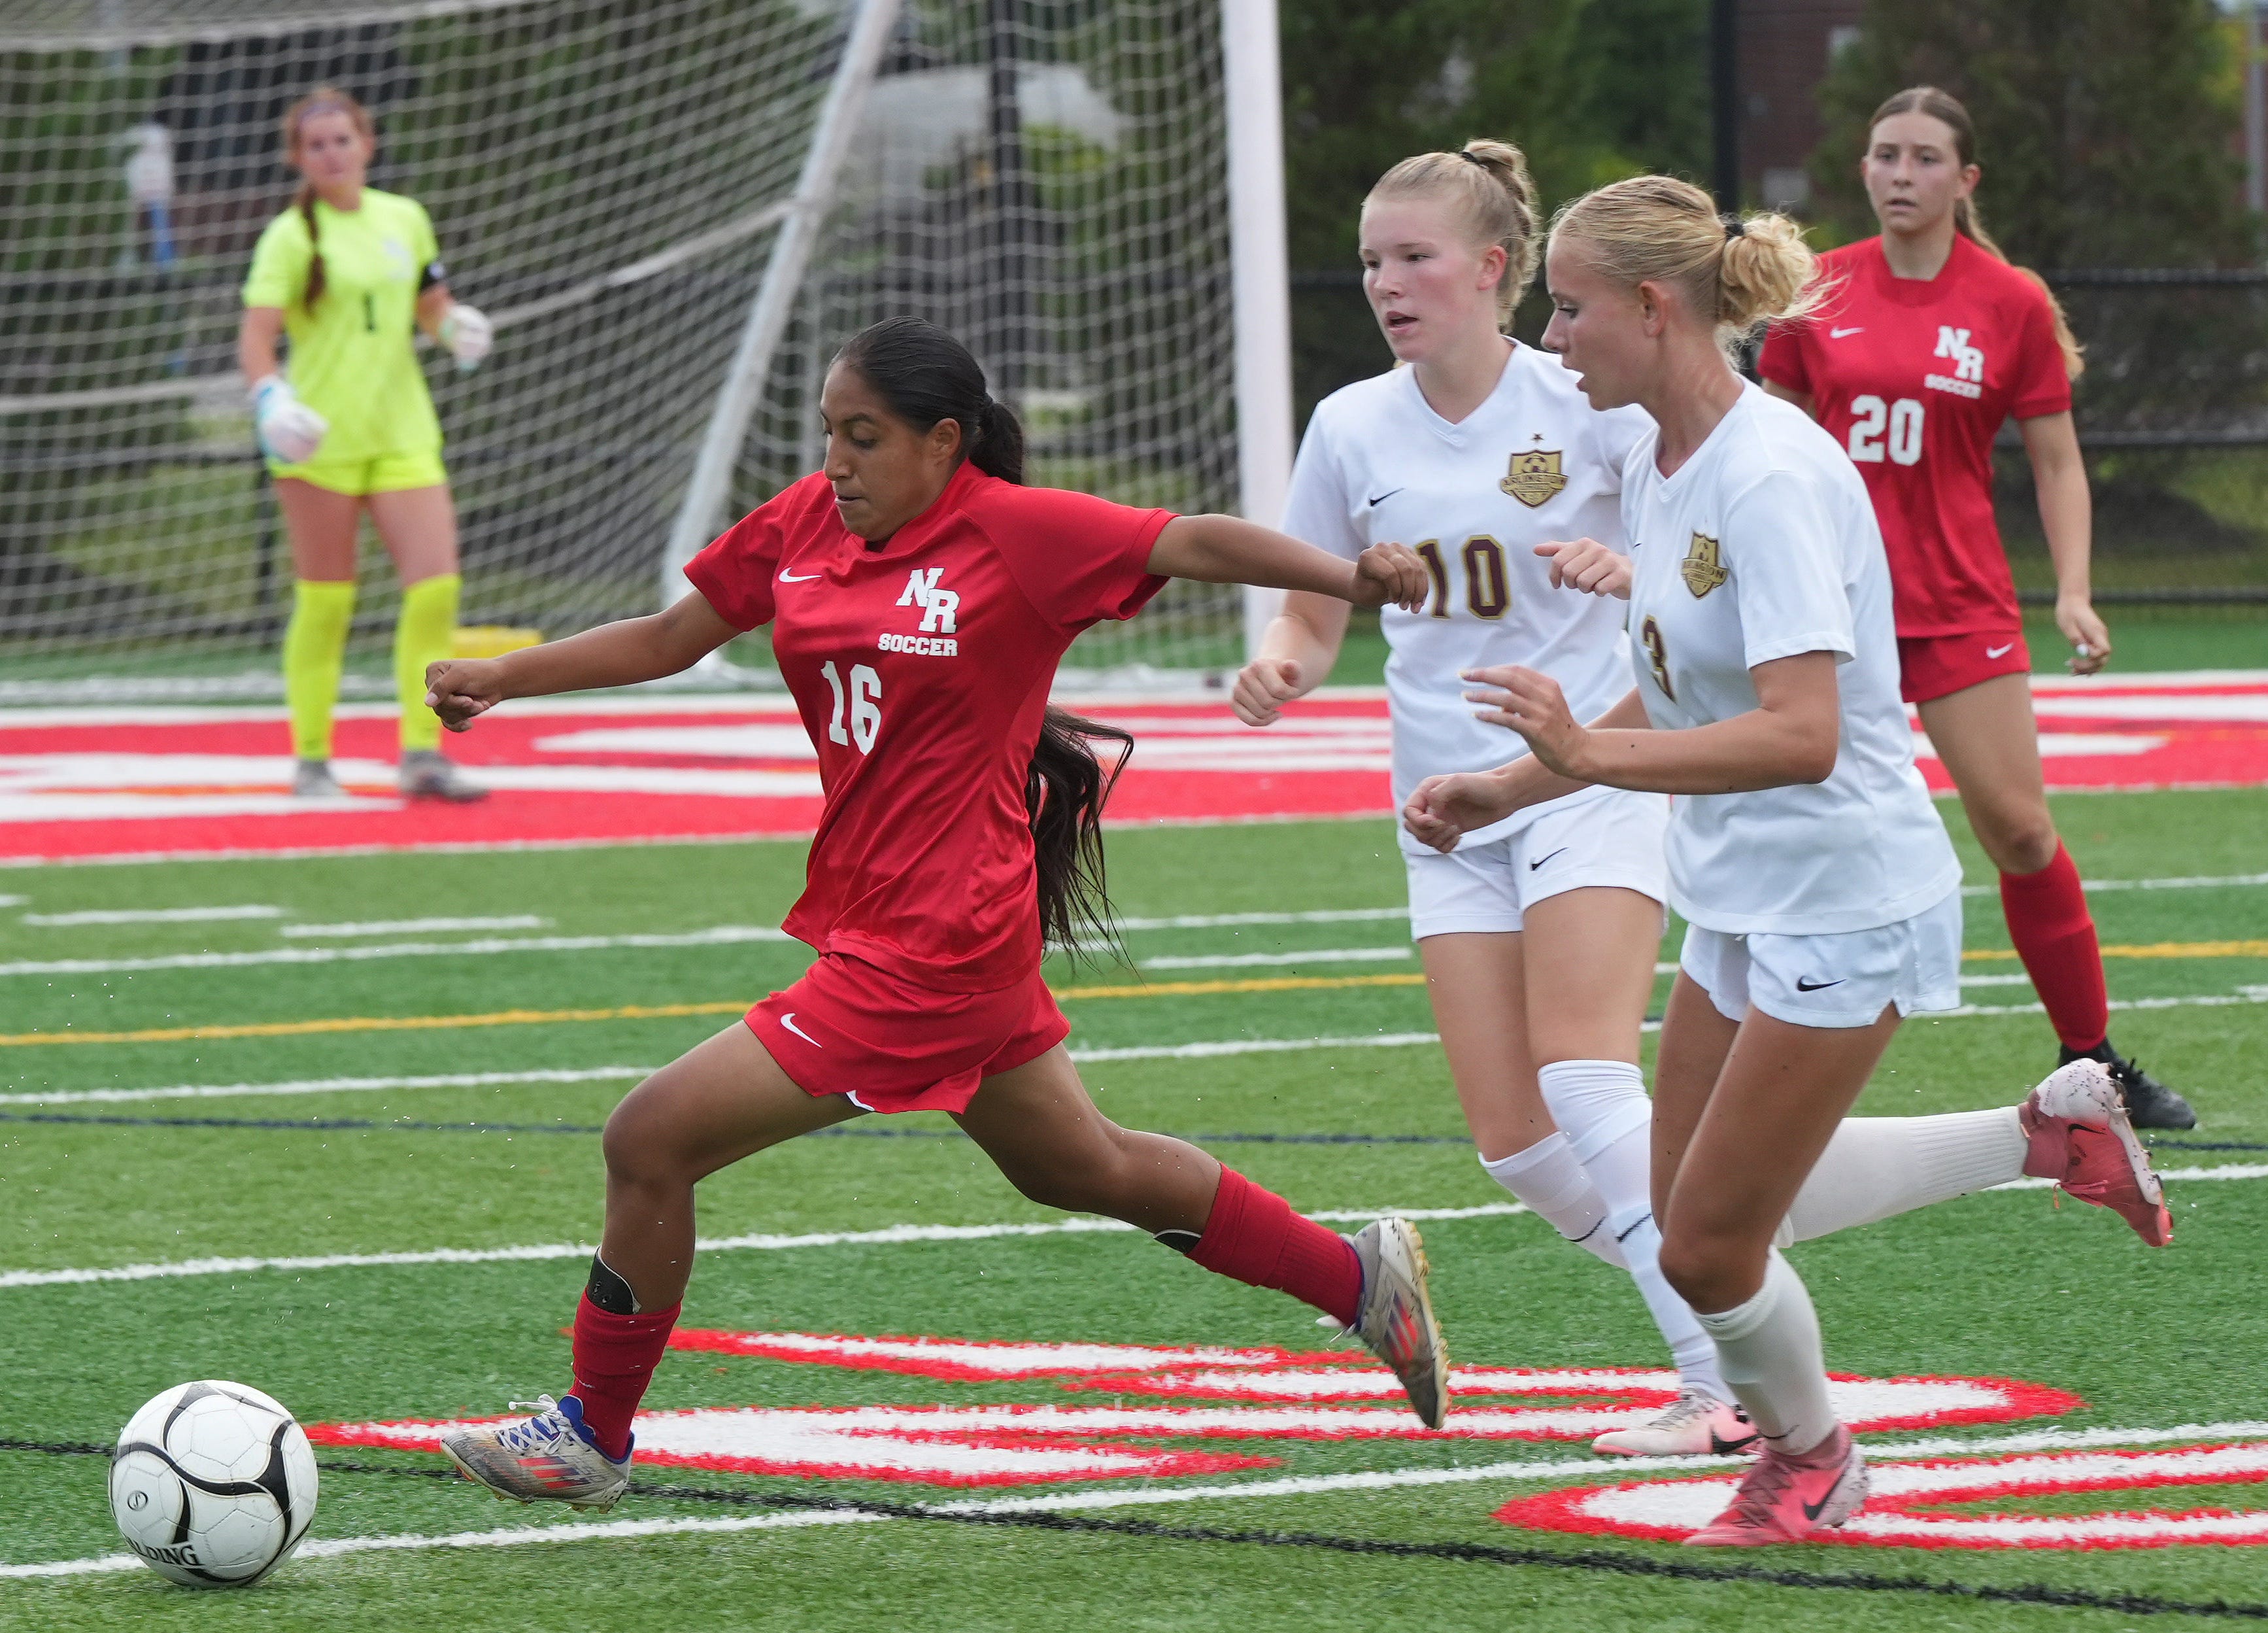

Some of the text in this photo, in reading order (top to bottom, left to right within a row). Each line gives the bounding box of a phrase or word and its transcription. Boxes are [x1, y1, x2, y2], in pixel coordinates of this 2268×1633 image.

[362, 290, 377, 333] 1
[1933, 325, 1985, 383] NR
[1924, 373, 1982, 399] SOCCER
[1848, 394, 1925, 466] 20
[895, 567, 960, 634] NR
[1414, 534, 1512, 620] 10
[877, 632, 958, 657] SOCCER
[821, 659, 882, 757] 16
